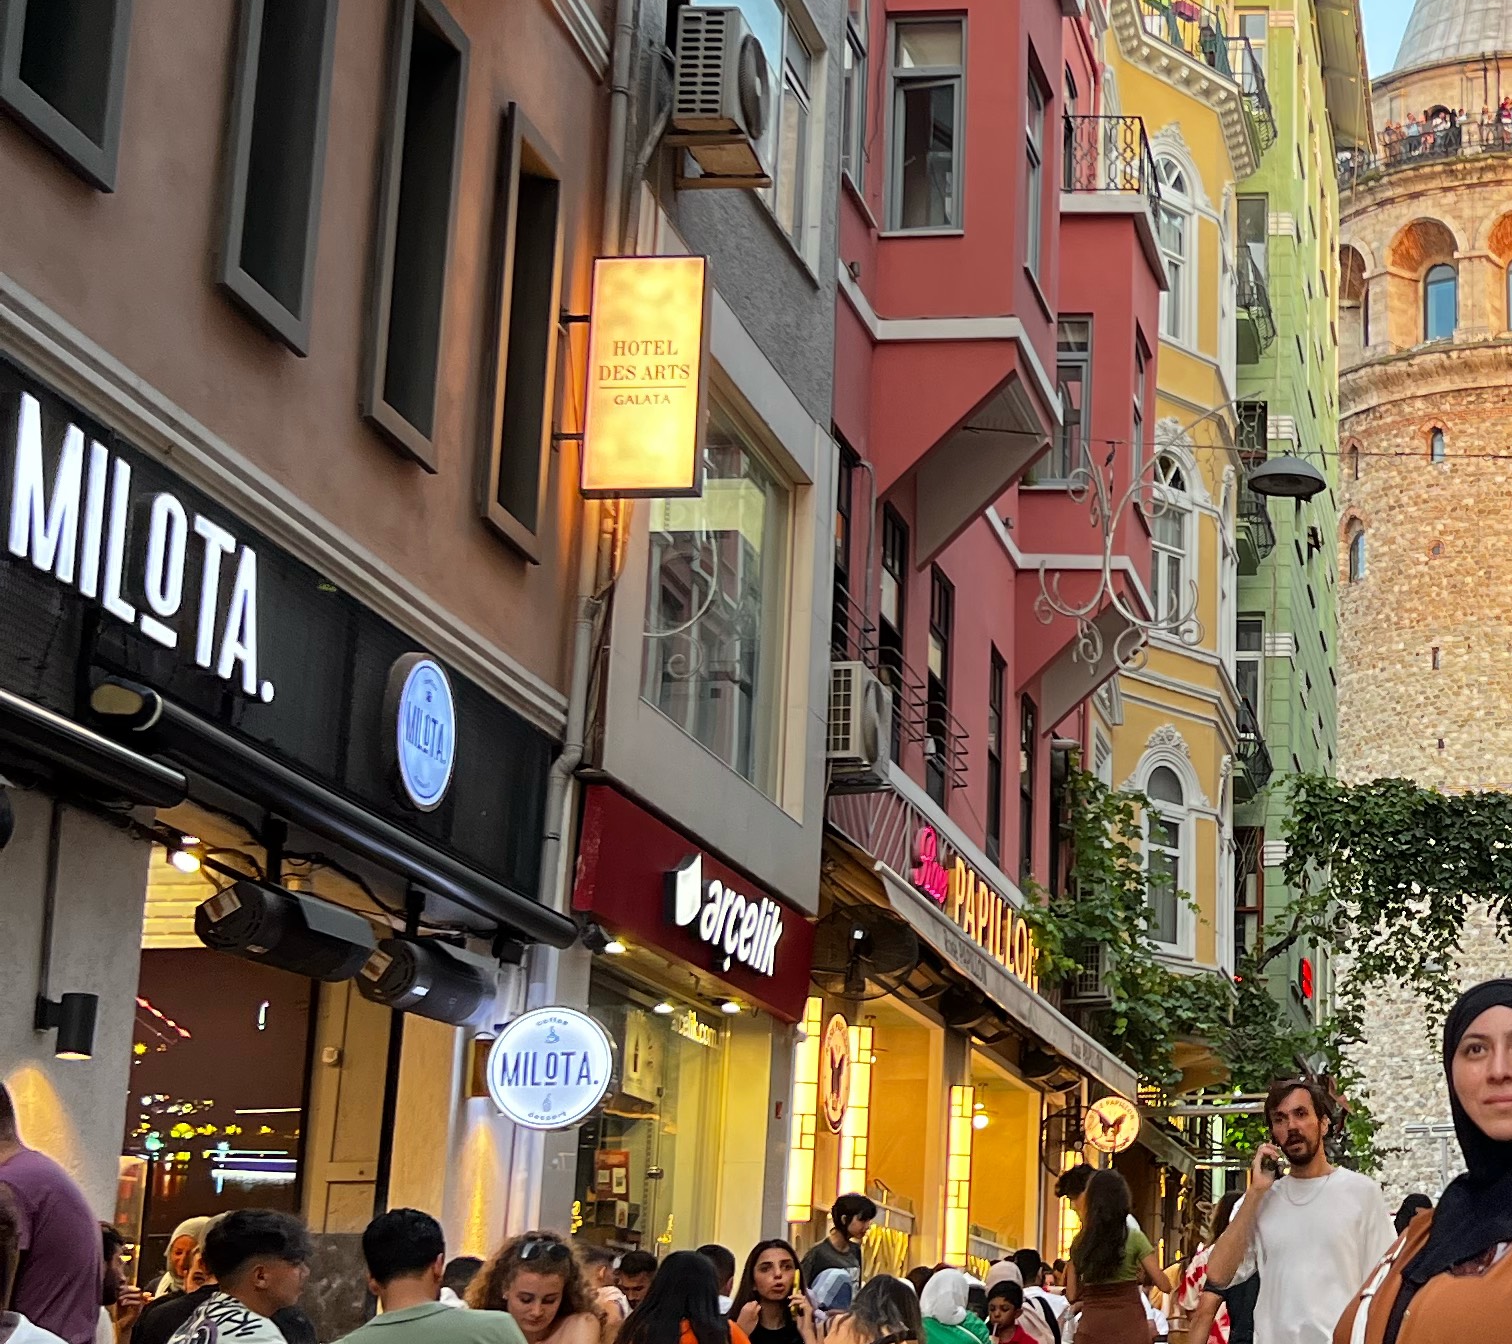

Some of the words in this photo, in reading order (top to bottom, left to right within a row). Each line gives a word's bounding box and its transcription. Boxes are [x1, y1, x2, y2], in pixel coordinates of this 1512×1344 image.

[613, 340, 678, 356] HOTEL
[598, 365, 637, 381] DES
[641, 364, 690, 381] ARTS
[613, 394, 671, 406] GALATA
[700, 879, 783, 976] arçelik
